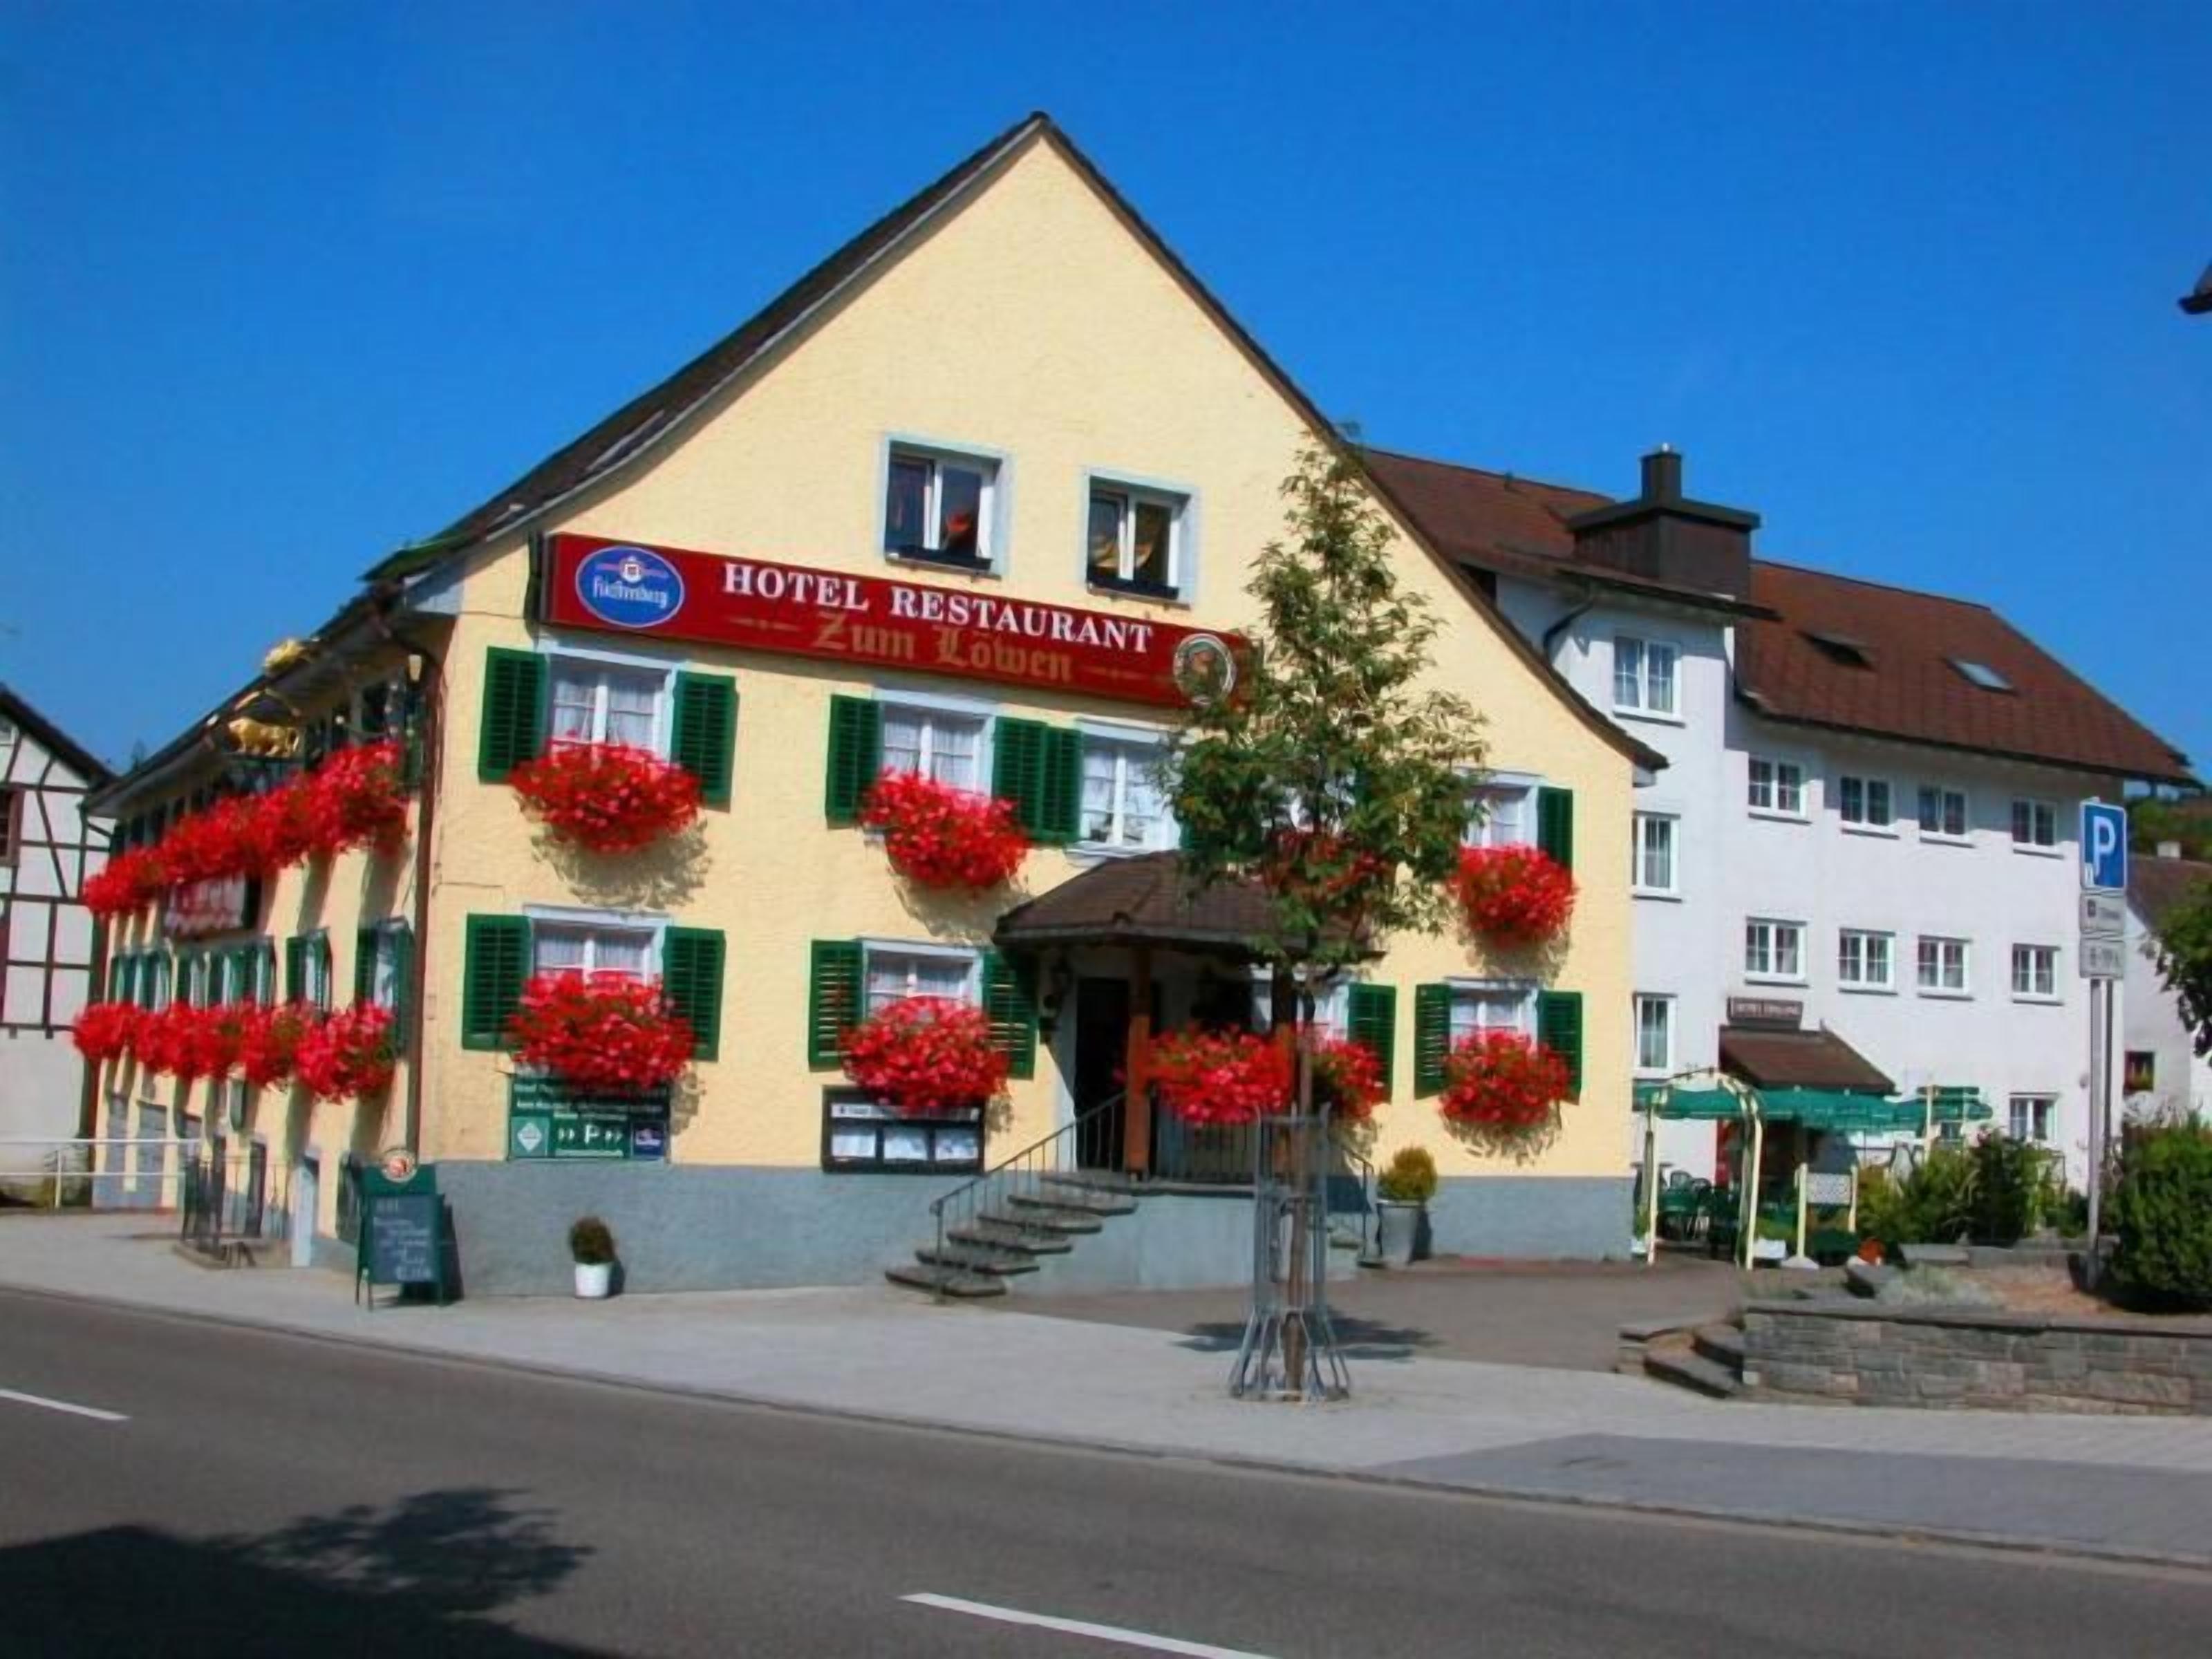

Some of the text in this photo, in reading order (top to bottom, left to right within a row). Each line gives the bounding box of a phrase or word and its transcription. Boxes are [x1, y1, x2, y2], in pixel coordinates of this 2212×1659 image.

[722, 562, 1154, 654] HOTEL RESTAURANT
[812, 611, 1074, 682] Zum Löwen
[2093, 816, 2116, 878] P
